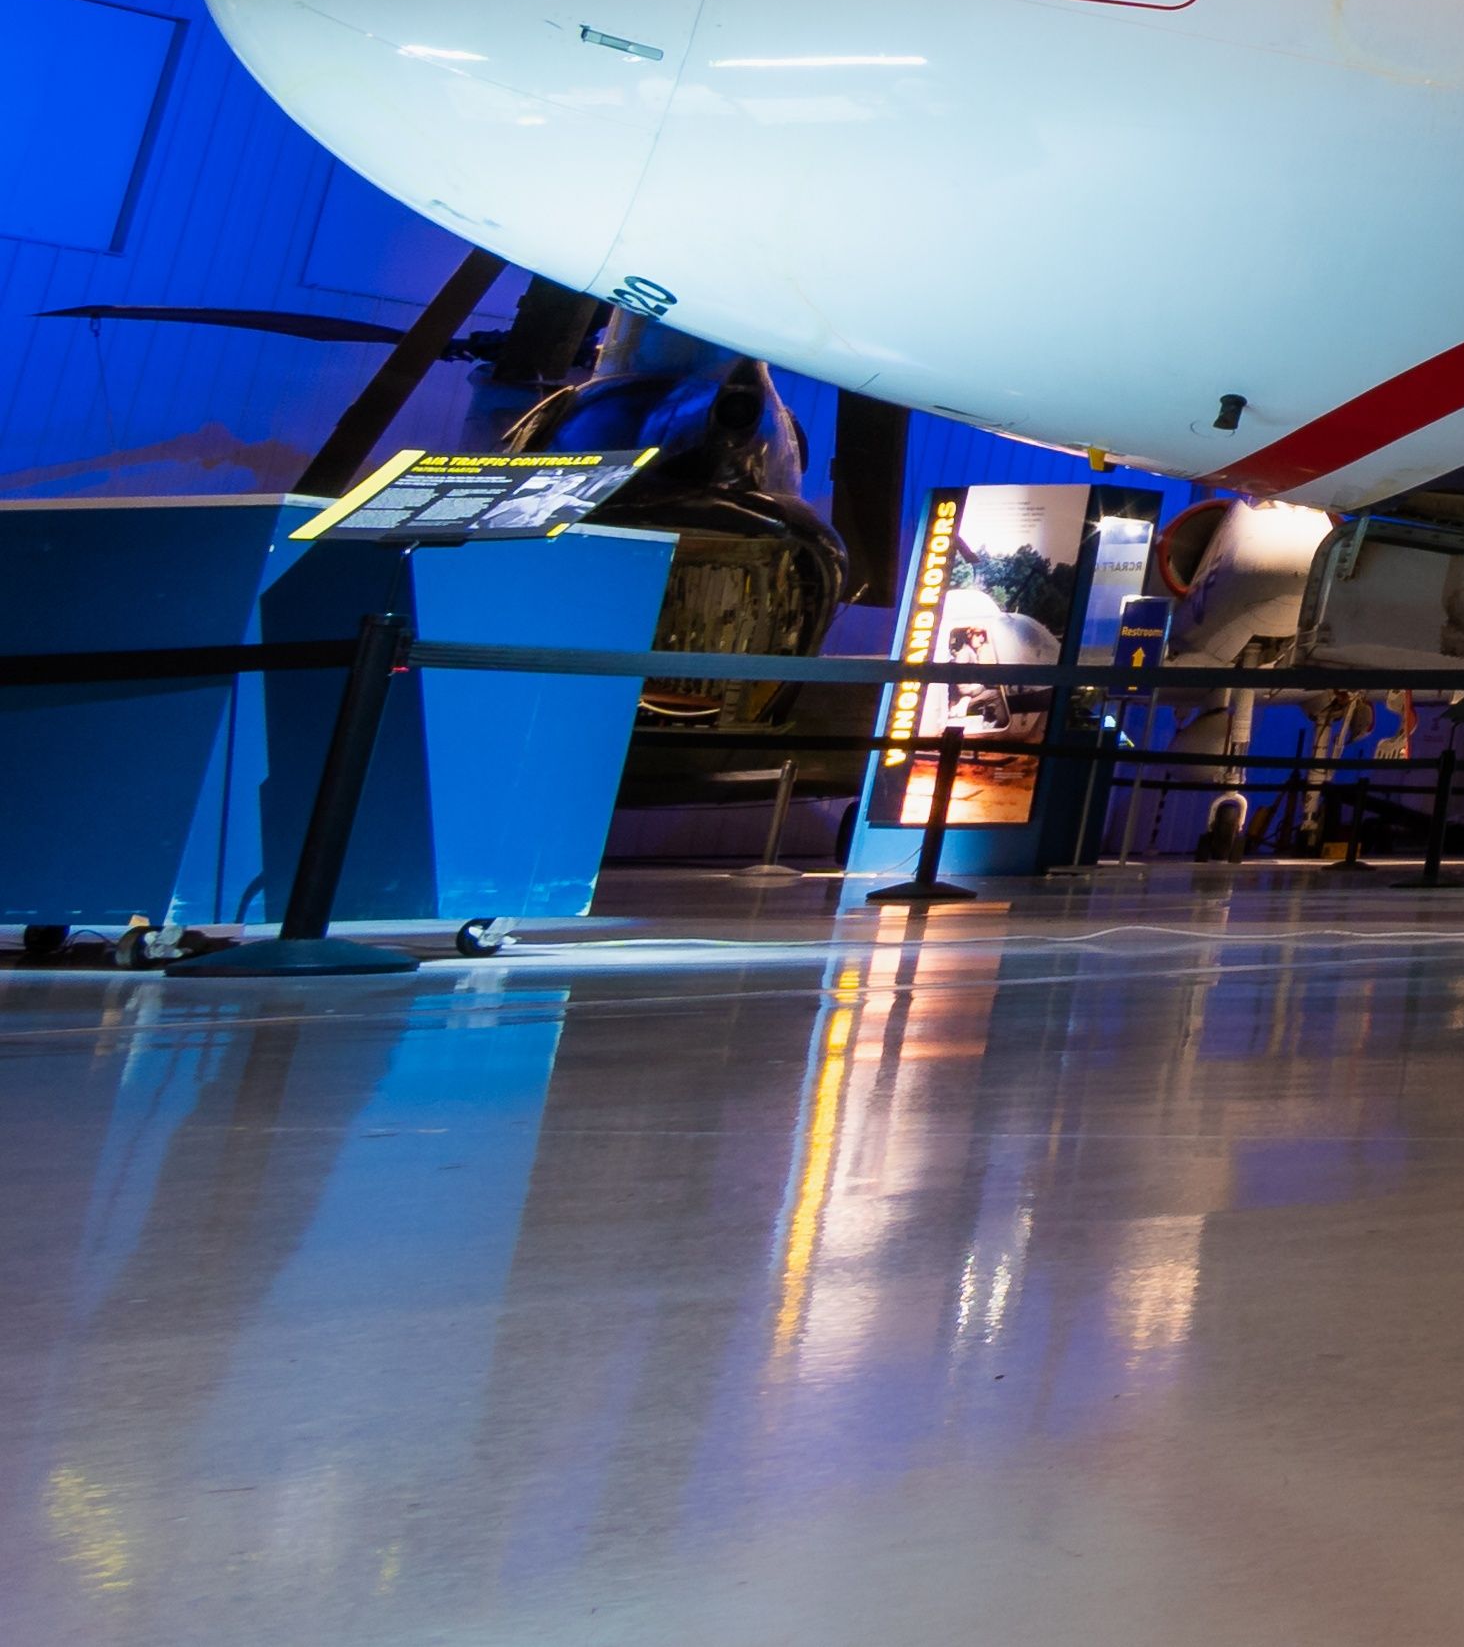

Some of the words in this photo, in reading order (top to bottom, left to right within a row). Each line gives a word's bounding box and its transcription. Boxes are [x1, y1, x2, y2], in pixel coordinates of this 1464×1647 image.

[419, 456, 449, 466] AIR
[449, 456, 510, 467] TRAFFIC
[508, 455, 603, 467] CONTROLLER
[918, 500, 957, 607] ROTORS
[907, 611, 936, 664] AND
[1121, 625, 1163, 637] Restrooms
